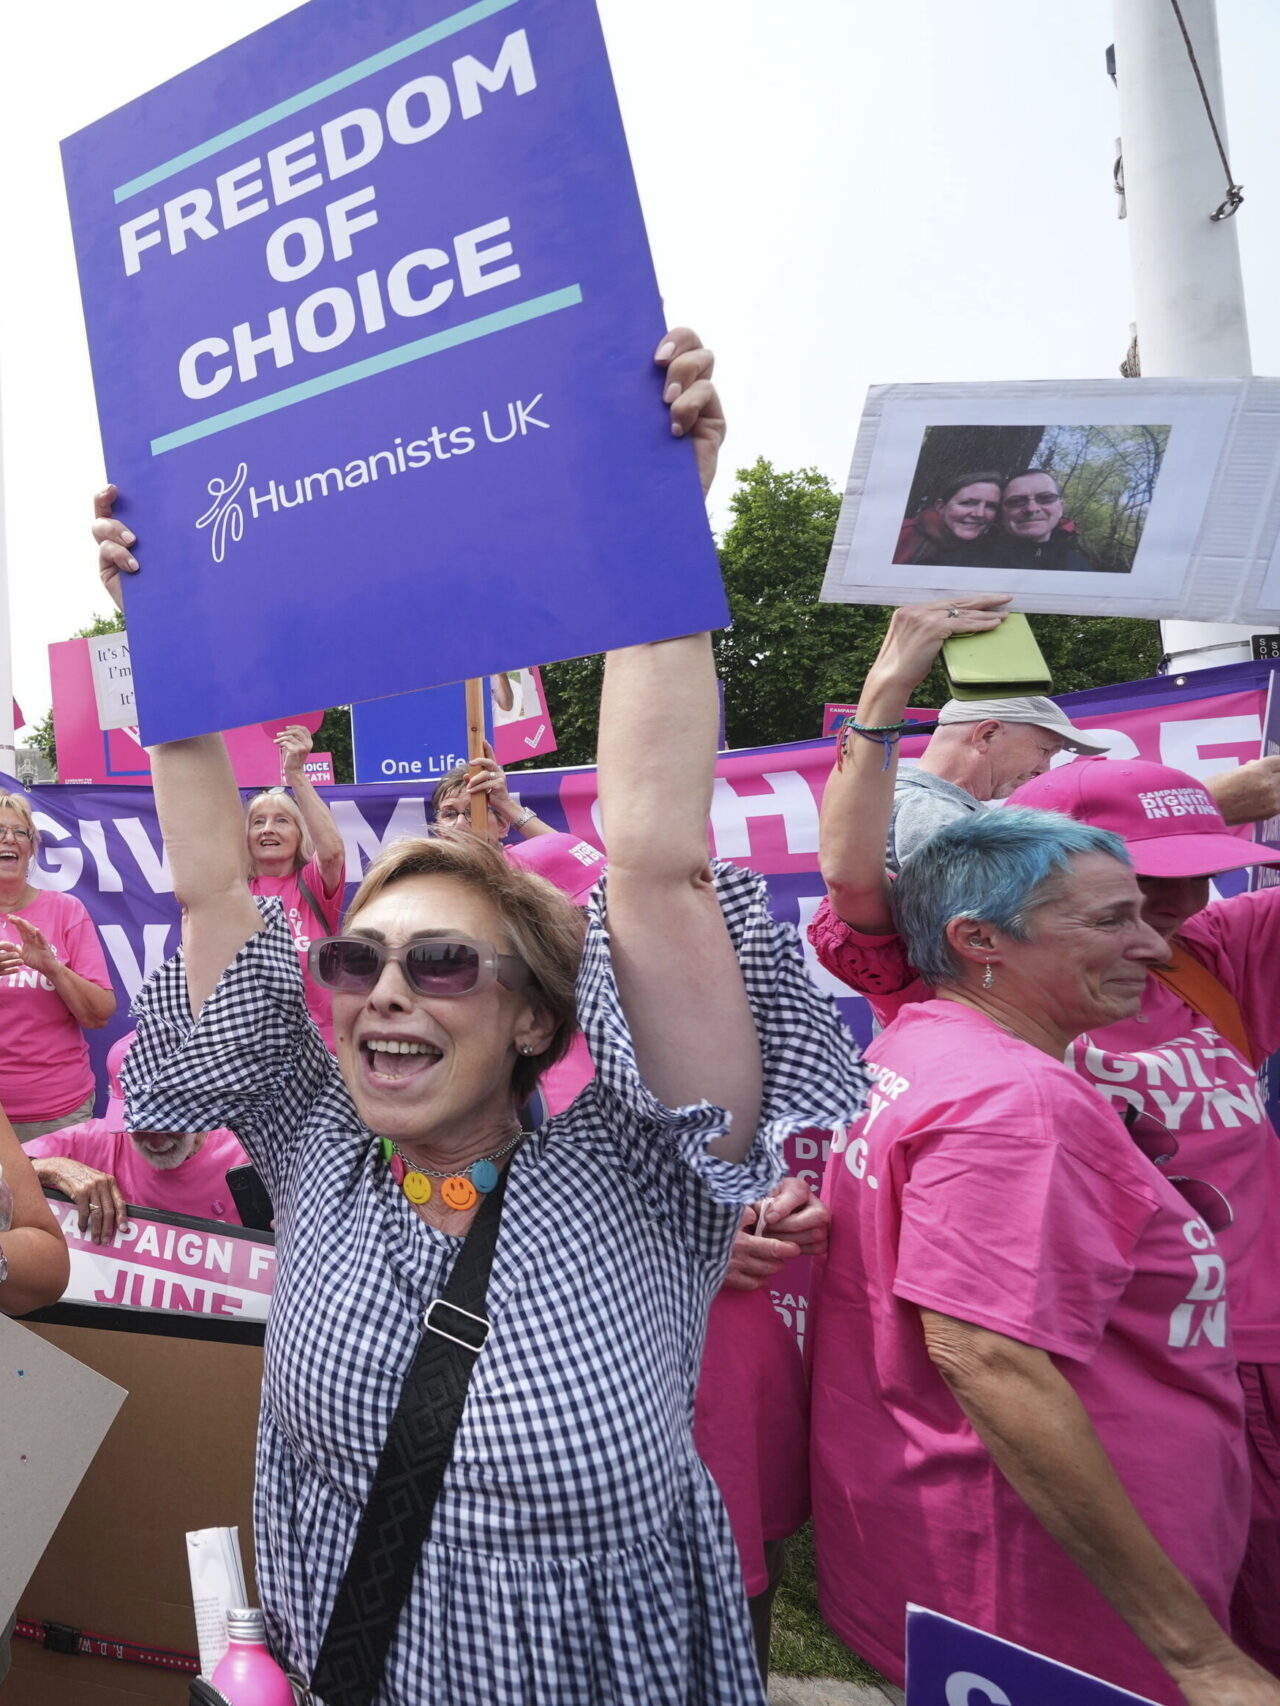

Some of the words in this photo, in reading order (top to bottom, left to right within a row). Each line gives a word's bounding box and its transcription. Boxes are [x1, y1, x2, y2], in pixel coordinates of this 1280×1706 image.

[120, 28, 537, 276] FREEDOM
[266, 185, 378, 283] OF
[179, 216, 521, 400] CHOICE
[250, 425, 476, 518] Humanists
[482, 393, 550, 444] UK
[303, 762, 329, 772] OICE
[305, 773, 330, 781] ATH
[381, 759, 422, 775] One
[428, 753, 466, 772] Life
[1140, 794, 1211, 809] DIGNIT
[1145, 807, 1170, 820] IN
[27, 811, 176, 894] GIV
[49, 1204, 234, 1274] APAIGN
